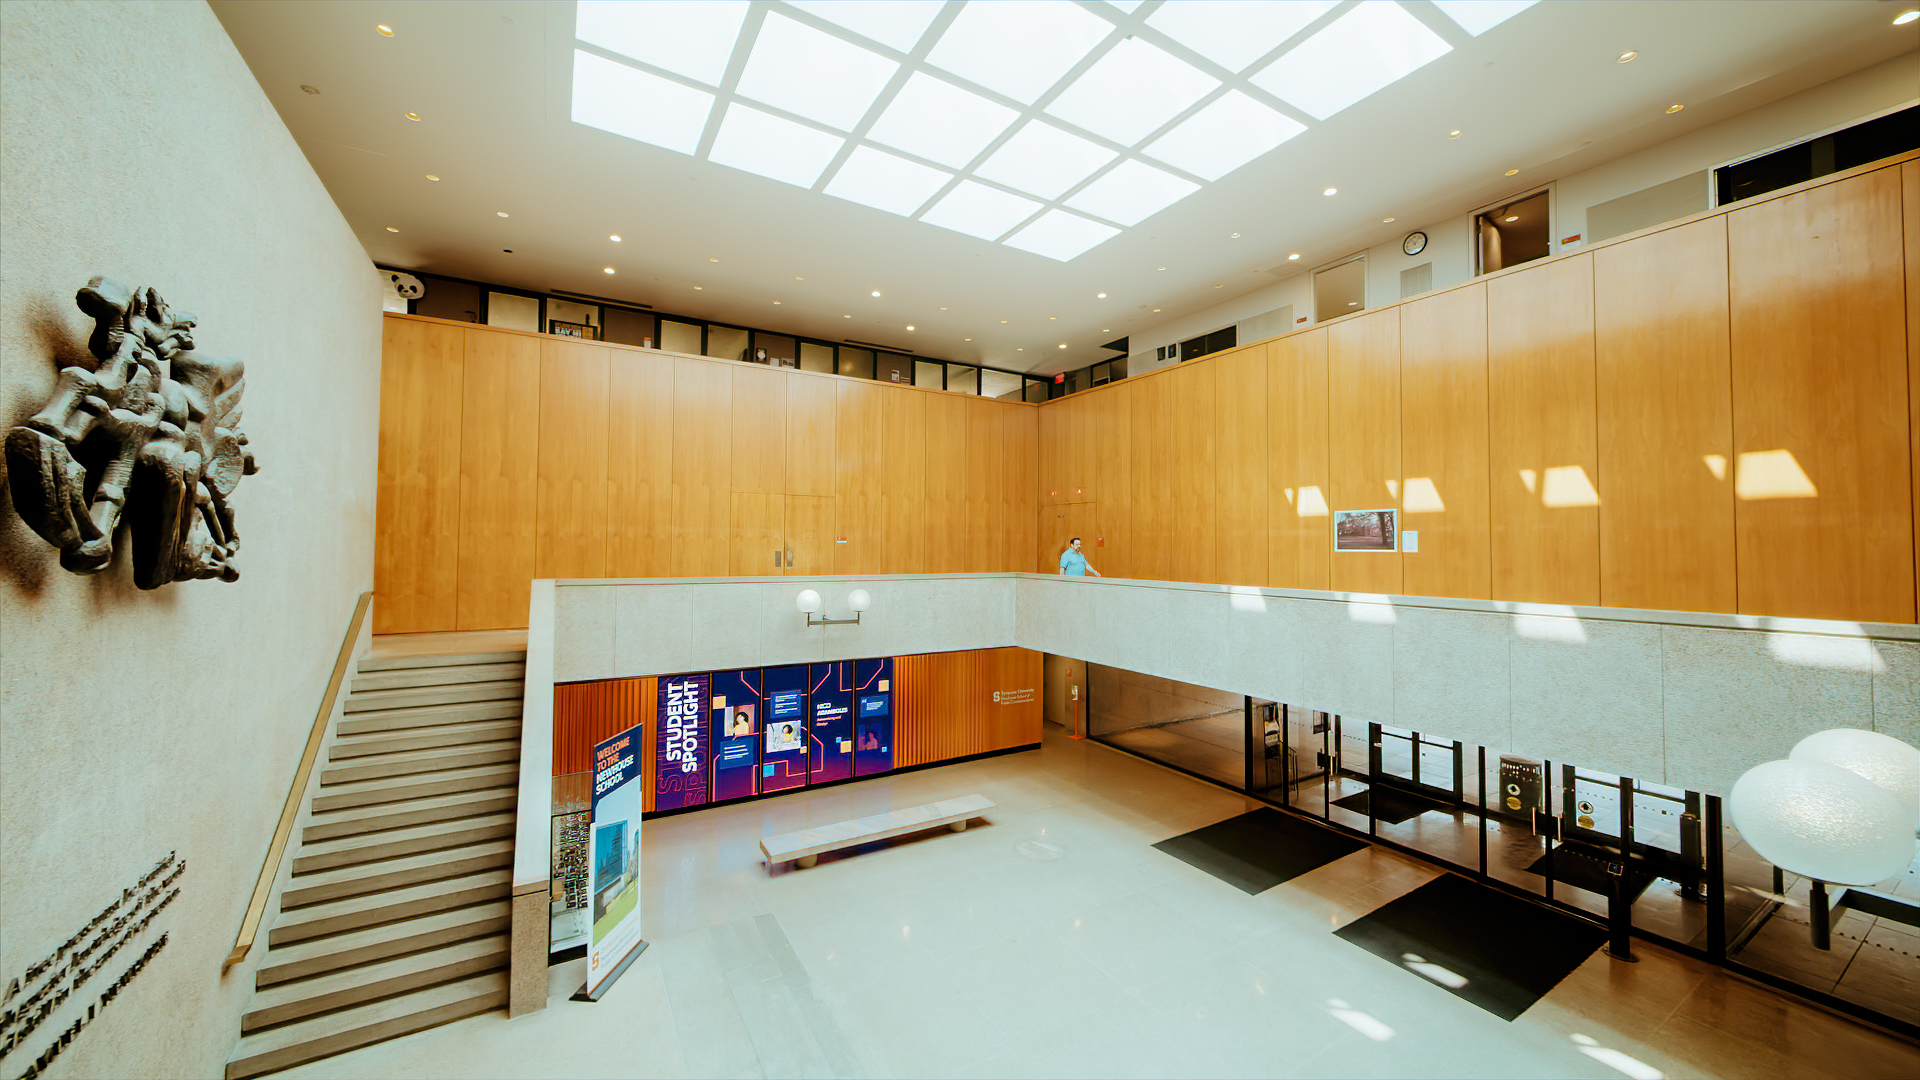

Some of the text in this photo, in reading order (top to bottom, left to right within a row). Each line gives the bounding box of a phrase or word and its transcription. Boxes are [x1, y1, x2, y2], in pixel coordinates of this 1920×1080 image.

[666, 683, 684, 762] STUDENT
[681, 681, 699, 773] SPOTLIGHT
[596, 752, 620, 772] TO THE
[597, 736, 630, 761] WELCOME
[596, 754, 634, 784] NEWHOUSE
[595, 772, 624, 795] SCHOOL
